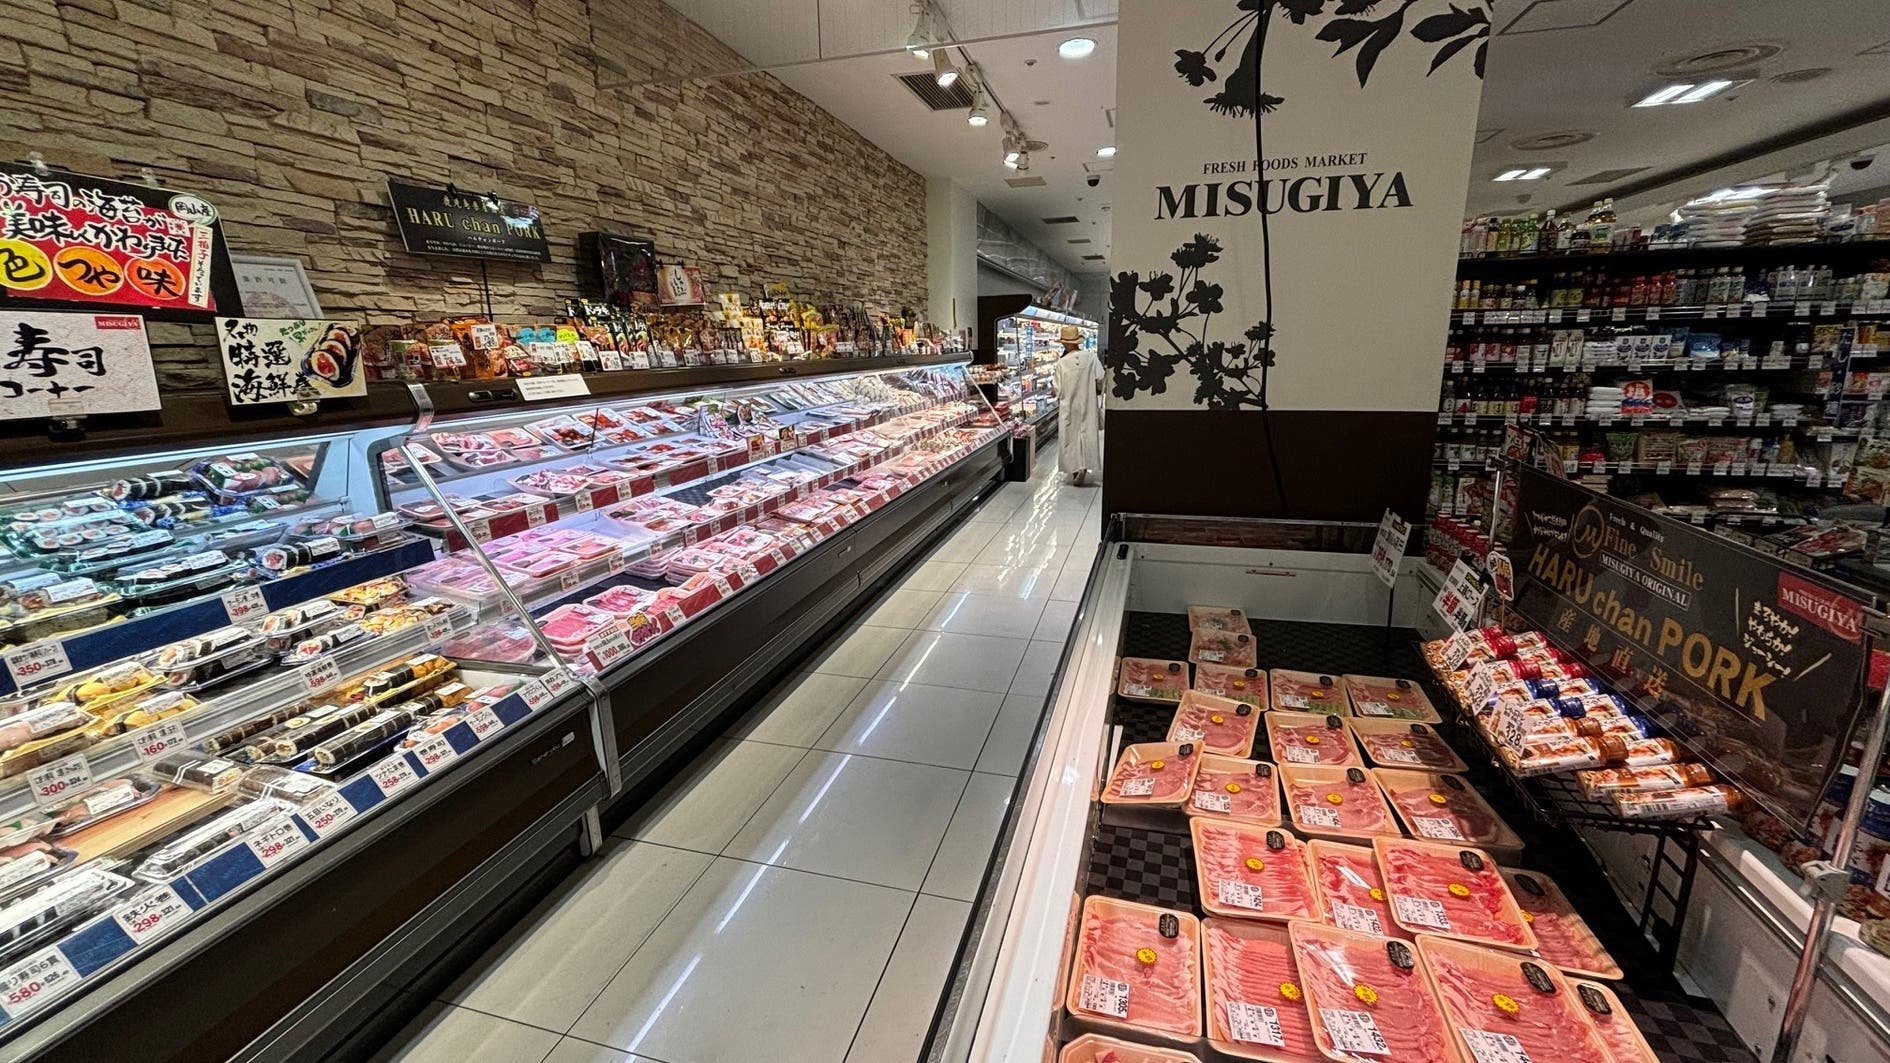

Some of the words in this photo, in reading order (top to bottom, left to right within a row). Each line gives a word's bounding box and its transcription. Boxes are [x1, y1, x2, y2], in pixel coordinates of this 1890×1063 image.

[1203, 160, 1246, 175] FRESH
[1252, 157, 1298, 171] FOODS
[1304, 152, 1368, 168] MARKET
[1154, 171, 1414, 220] MISUGIYA
[406, 207, 454, 229] HARU
[461, 217, 501, 234] chan
[506, 223, 541, 240] PORK
[0, 248, 46, 283] 色
[57, 258, 121, 290] つや
[136, 265, 180, 298] 味
[3, 322, 107, 377] 寿司
[229, 340, 292, 369] 特選
[0, 380, 95, 398] コーナー
[1604, 525, 1638, 560] Fine
[1650, 546, 1705, 592] Smile
[1602, 553, 1640, 583] MISUGIYA
[1641, 574, 1689, 608] ORIGINAL
[1781, 587, 1857, 634] MISUGIYA
[1528, 543, 1594, 605] HARU
[1593, 589, 1653, 647] chan
[1656, 617, 1779, 722] PORK
[17, 661, 42, 676] 350
[144, 742, 165, 756] 160
[41, 781, 67, 796] 300
[383, 770, 399, 789] 258
[314, 813, 334, 829] 250
[261, 842, 284, 858] 298
[133, 913, 161, 933] 298
[8, 981, 42, 1004] 580
